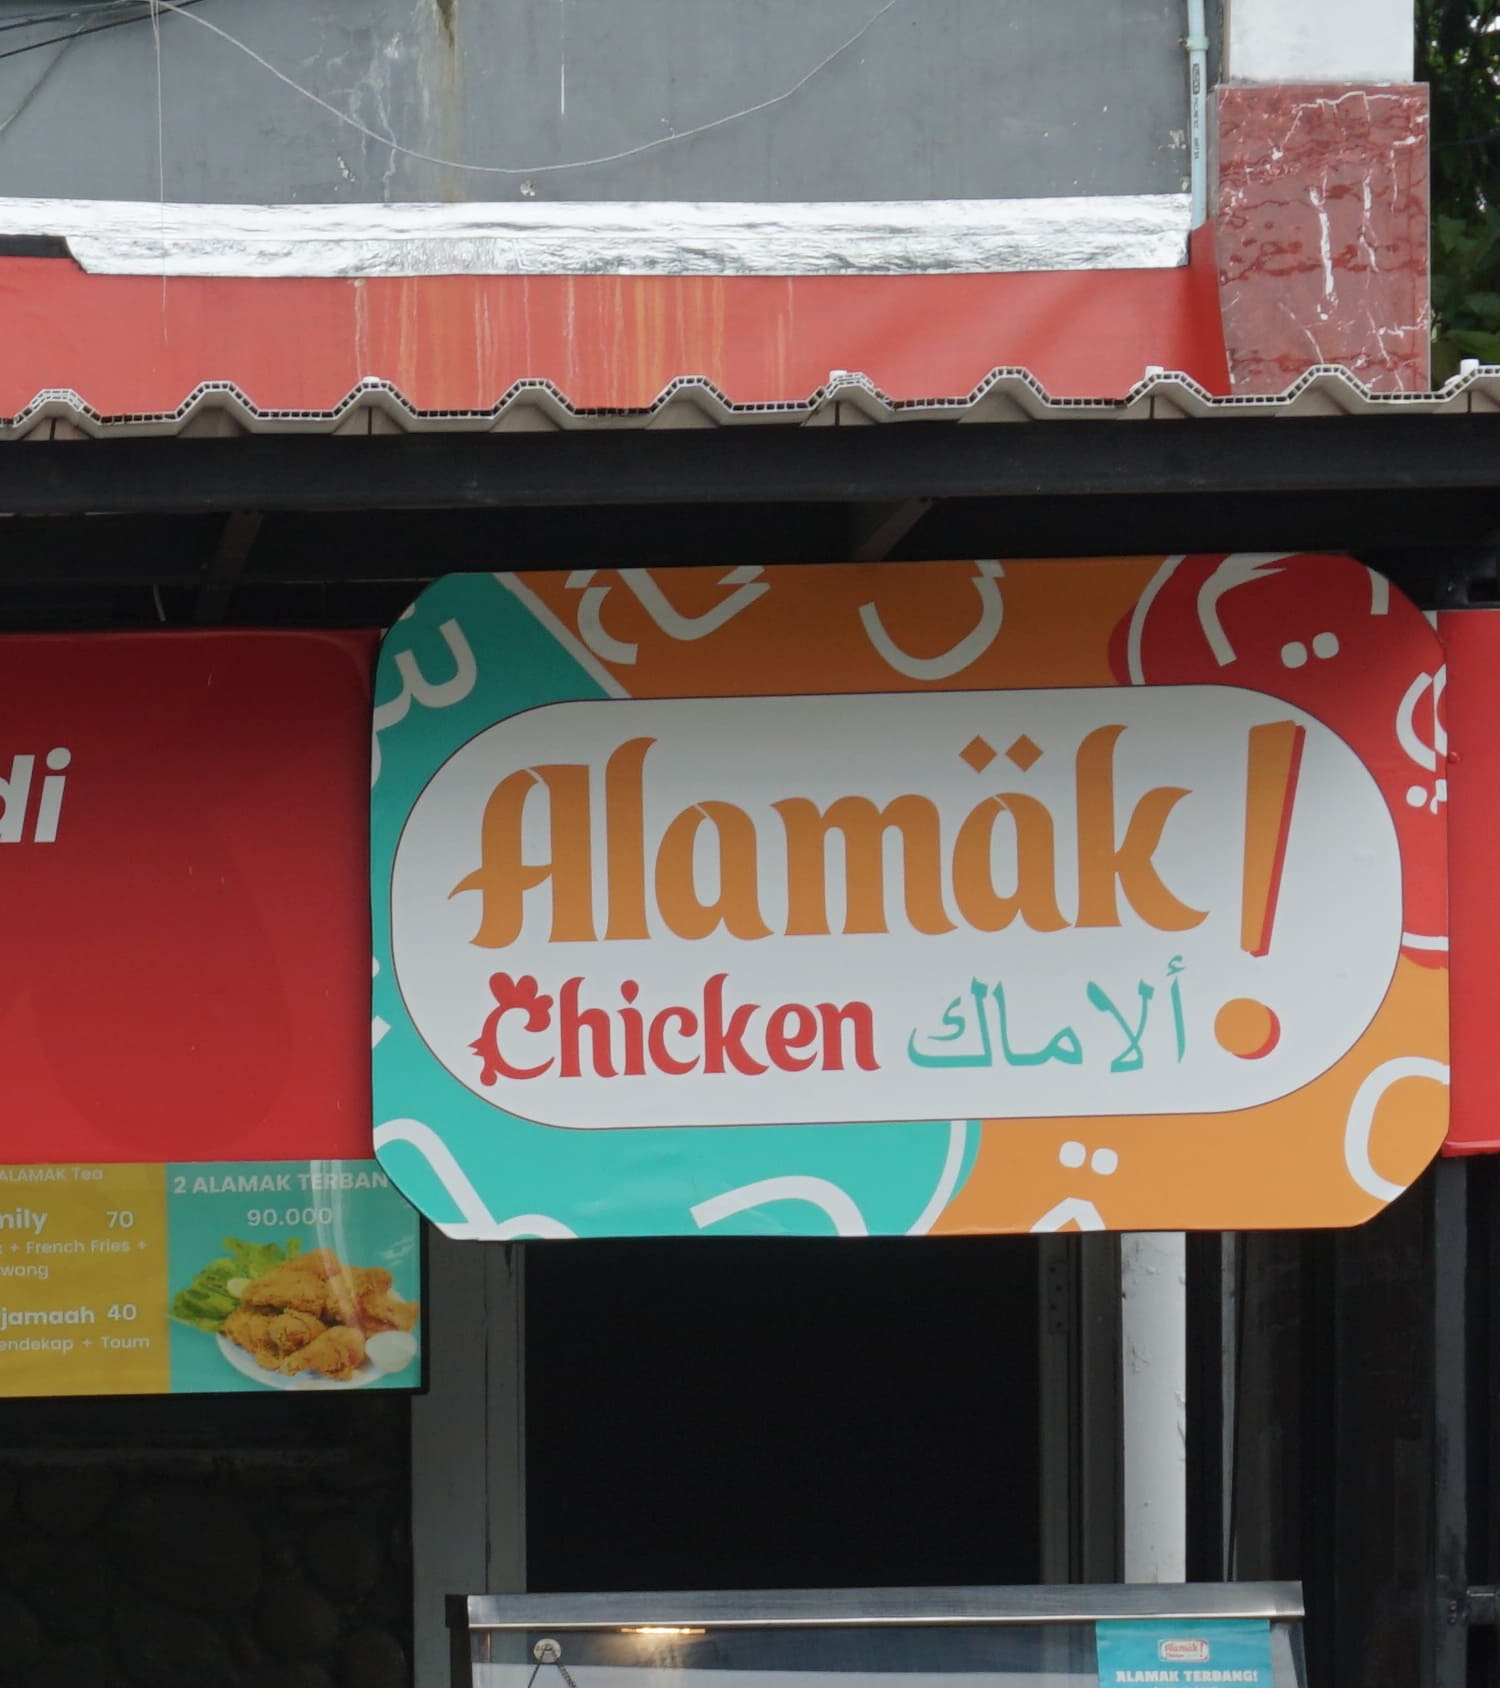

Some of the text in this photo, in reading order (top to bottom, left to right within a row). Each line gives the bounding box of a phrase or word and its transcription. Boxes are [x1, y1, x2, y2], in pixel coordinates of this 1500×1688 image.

[470, 972, 881, 1086] Chicken
[71, 1166, 104, 1181] Tea
[173, 1176, 187, 1194] 2
[192, 1174, 291, 1193] ALAMAK
[106, 1210, 135, 1228] 70
[247, 1208, 333, 1226] 90.000
[25, 1239, 85, 1254] French
[90, 1238, 131, 1253] Fries
[107, 1304, 137, 1321] 40
[101, 1335, 150, 1349] Toum
[1116, 1670, 1179, 1682] ALAMAK
